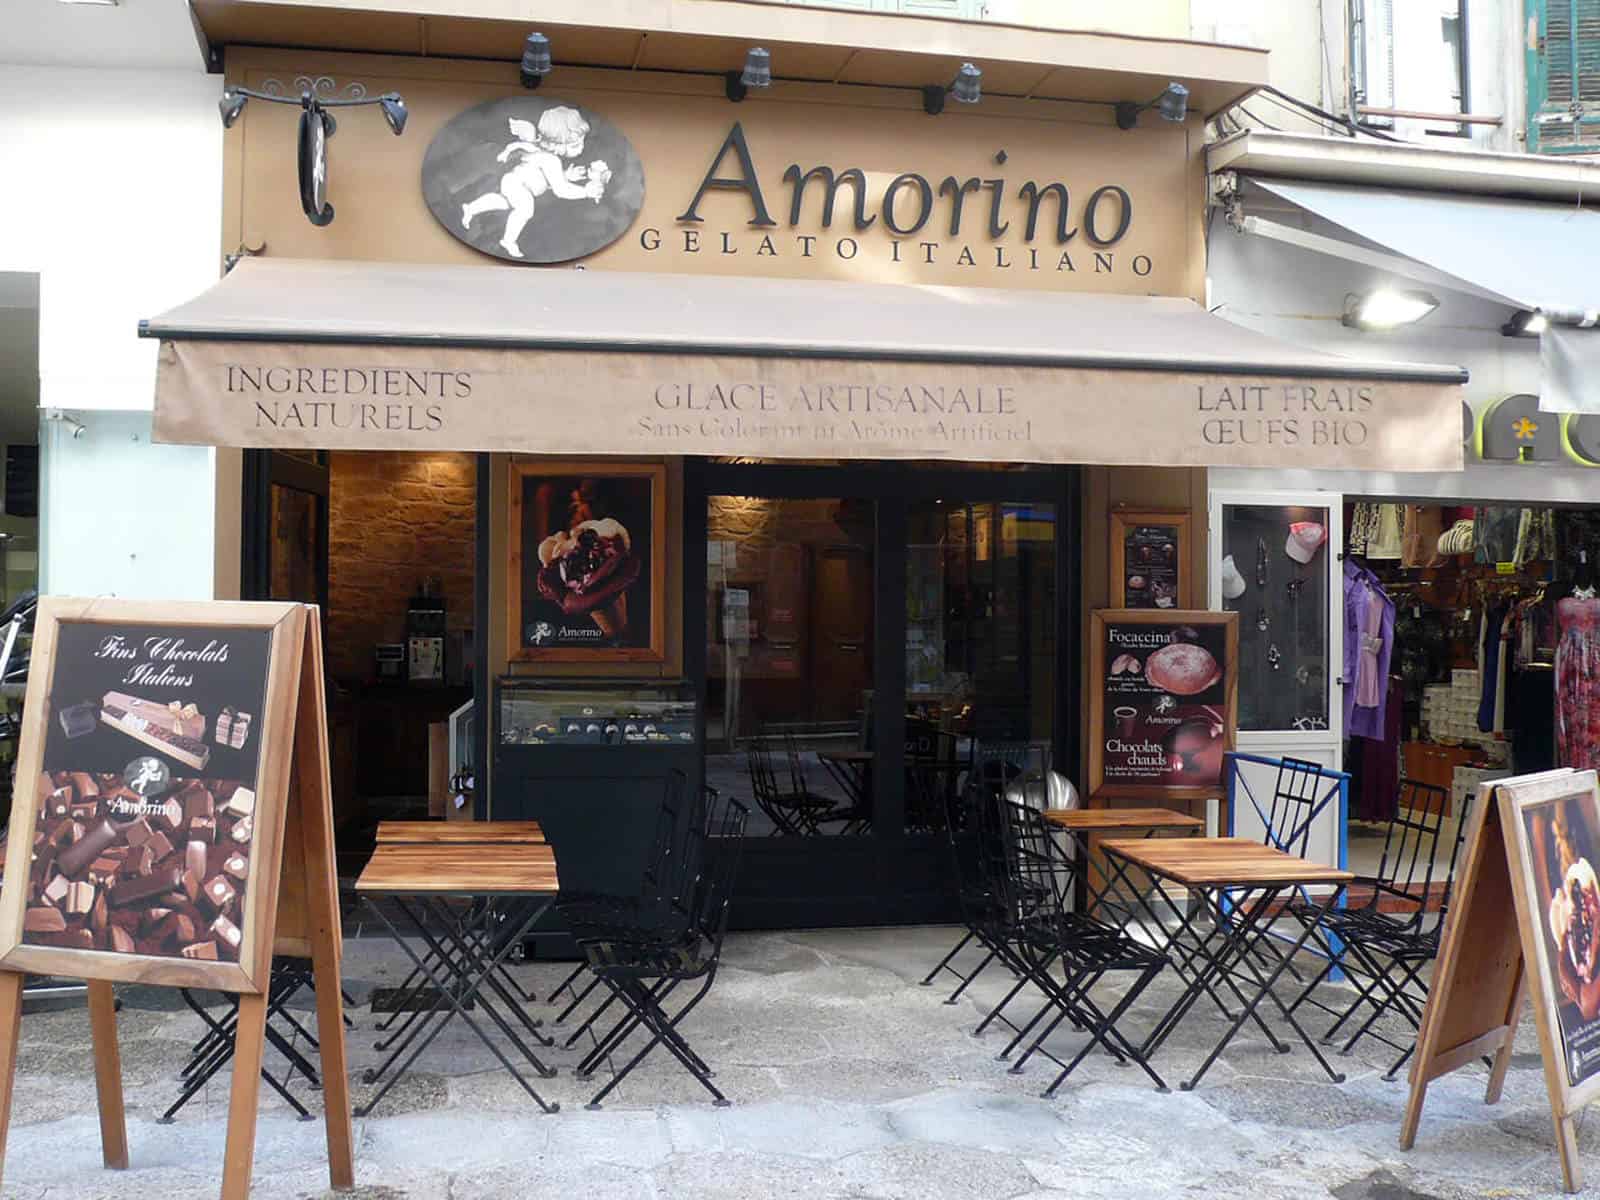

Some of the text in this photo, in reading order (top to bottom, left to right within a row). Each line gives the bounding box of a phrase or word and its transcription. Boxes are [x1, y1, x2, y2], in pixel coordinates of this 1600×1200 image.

[675, 120, 1132, 246] Amorino
[640, 227, 1153, 276] GELATO ITALIANO
[226, 365, 472, 398] INGREDIENTS
[653, 382, 1017, 415] GLACE ARTISANALE
[1197, 385, 1373, 413] LAIT FRAIS
[255, 401, 444, 432] NATURELS
[637, 416, 691, 439] Sans
[1311, 420, 1368, 446] BIO
[94, 634, 230, 663] Fins Chocolats
[1109, 629, 1170, 643] Focaccina
[122, 663, 194, 687] Italiens
[1106, 738, 1163, 753] Chocolats
[1127, 751, 1167, 766] chauds
[107, 796, 177, 817] Amorino
